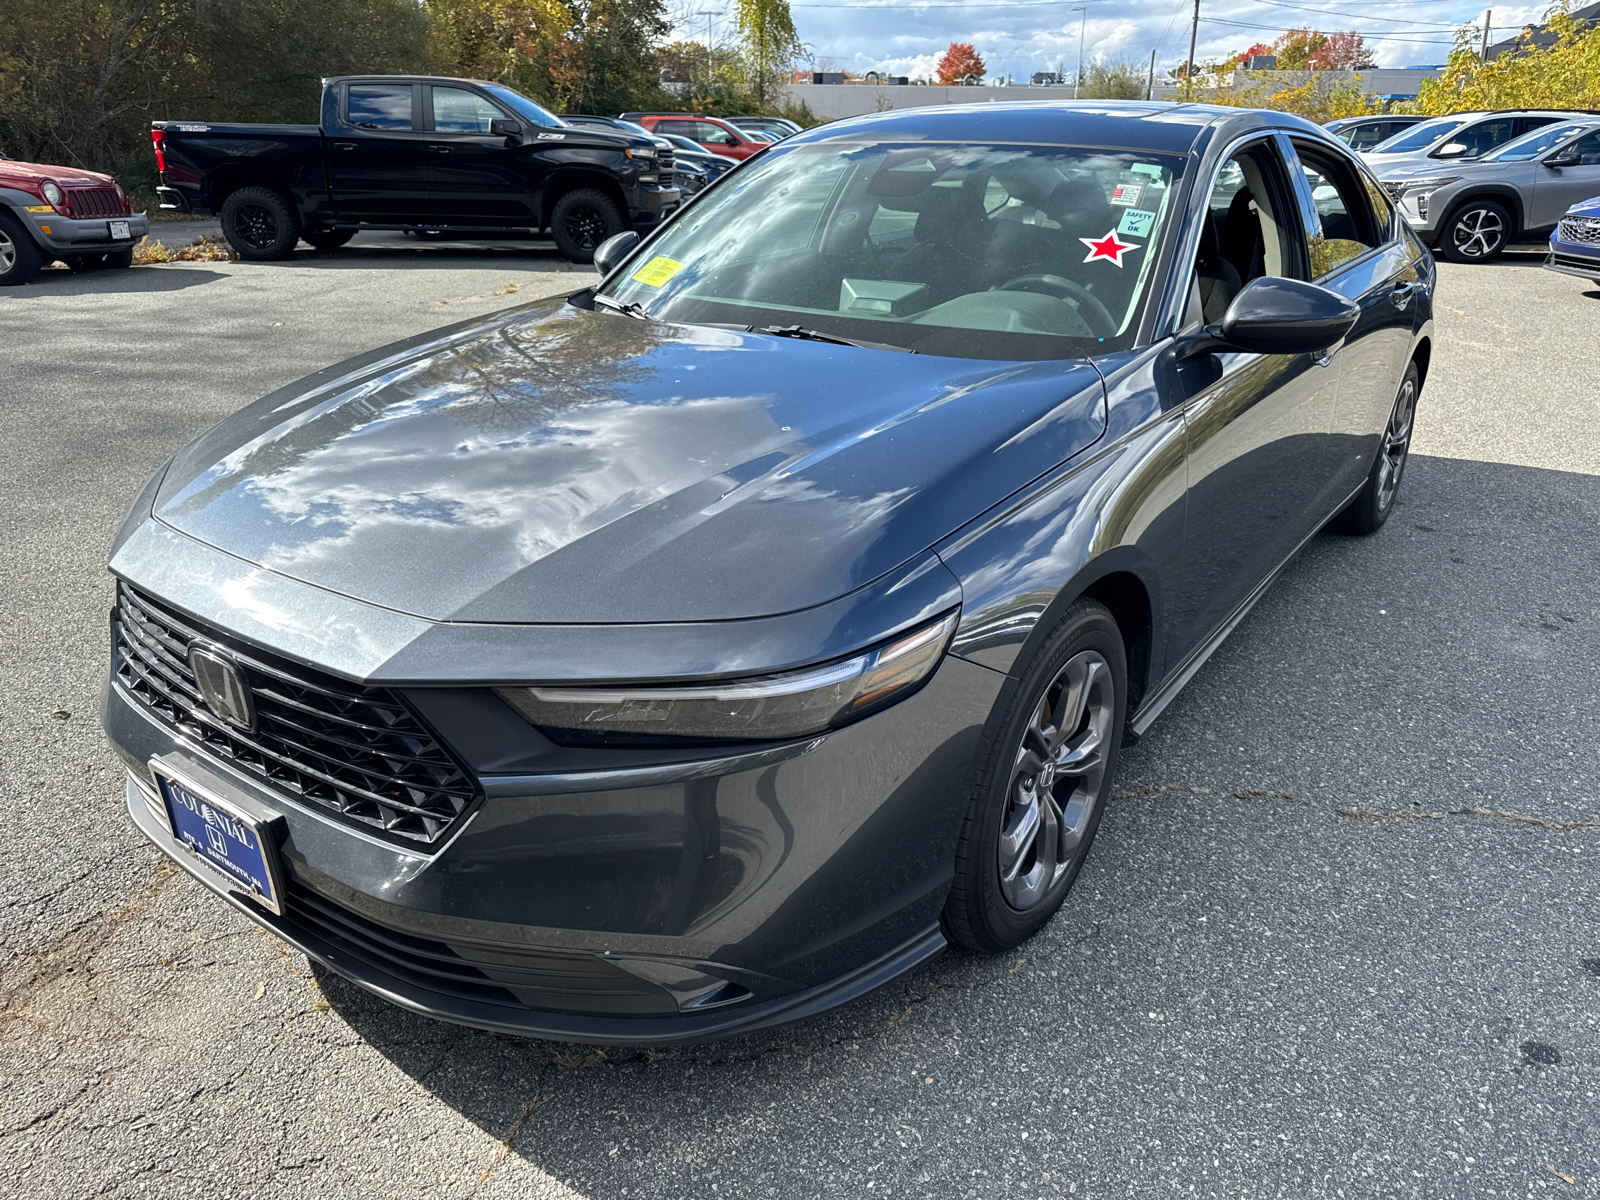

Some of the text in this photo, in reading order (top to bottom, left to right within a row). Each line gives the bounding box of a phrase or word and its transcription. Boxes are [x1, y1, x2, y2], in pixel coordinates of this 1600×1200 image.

[1126, 211, 1152, 220] SAFETY
[170, 787, 254, 849] COLONIAL
[207, 847, 251, 883] DARTMOUTH,
[251, 876, 263, 889] MA
